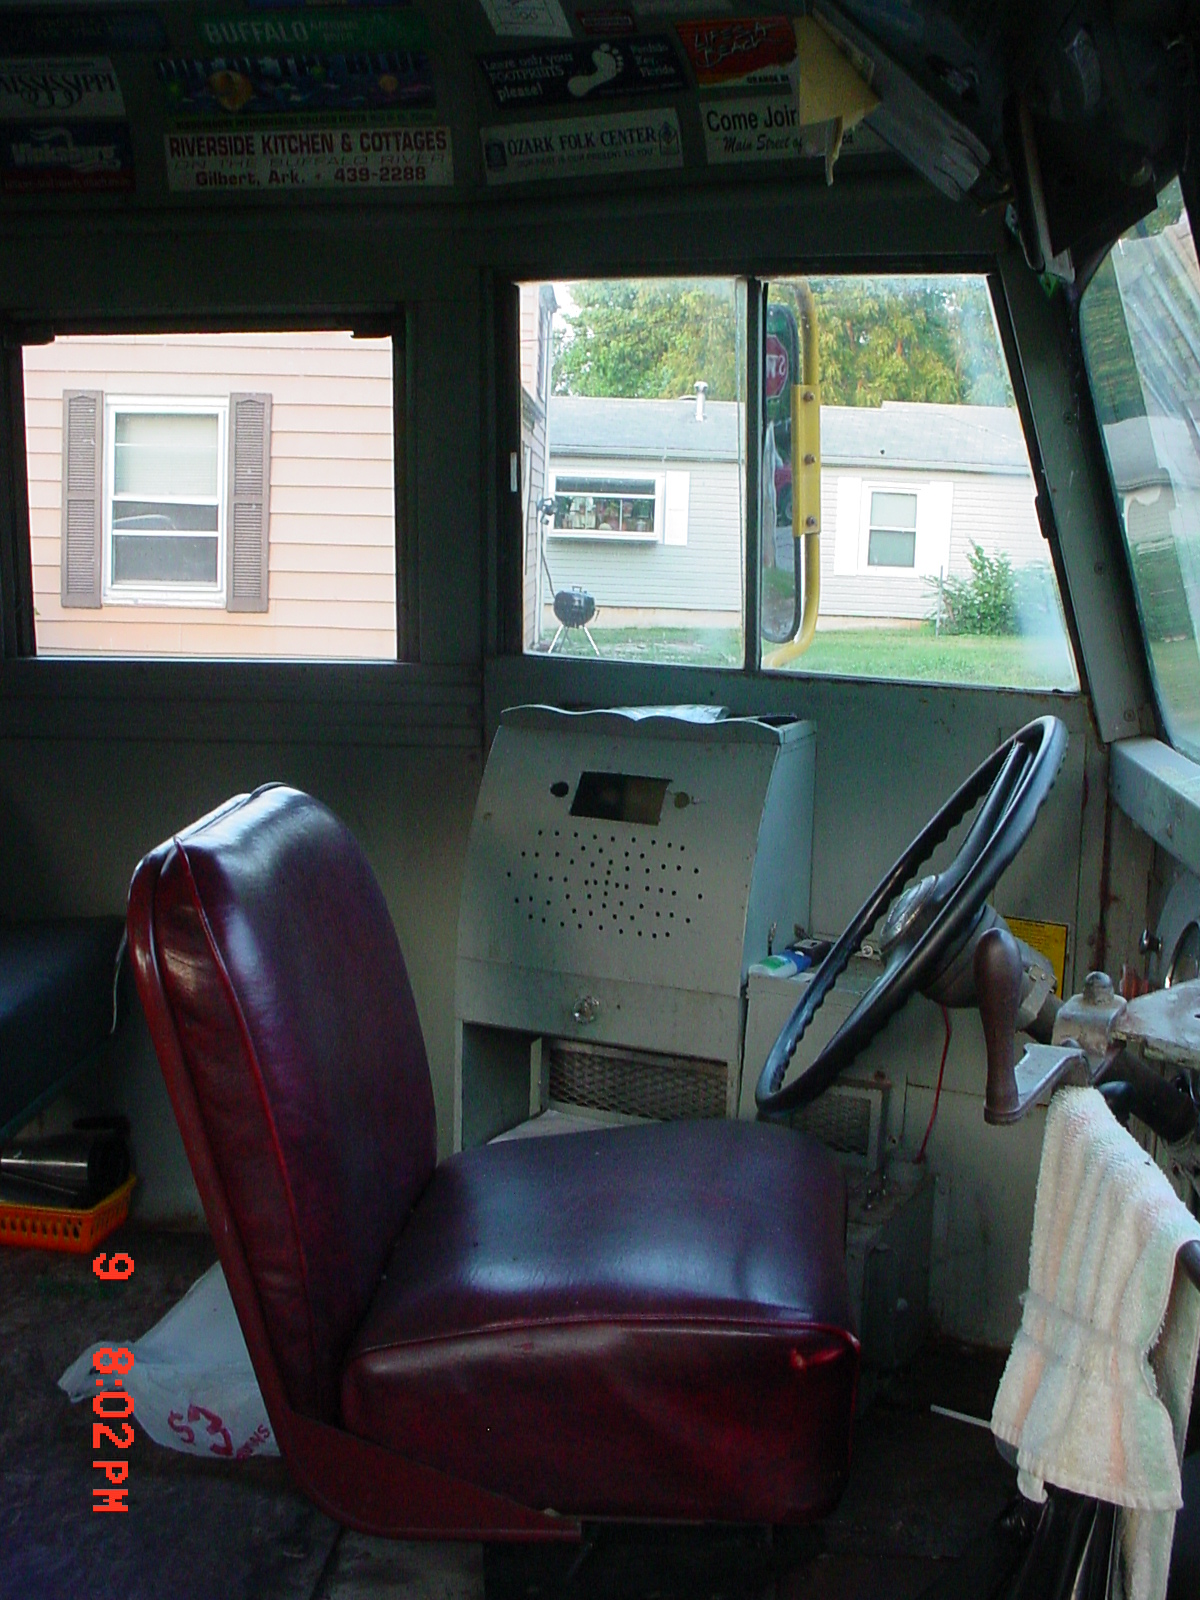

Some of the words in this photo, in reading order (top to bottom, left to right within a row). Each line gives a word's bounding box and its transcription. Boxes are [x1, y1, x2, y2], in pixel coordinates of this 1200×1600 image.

[204, 21, 309, 44] BUFFALO
[488, 64, 565, 85] FOOTPRINTS
[706, 110, 759, 132] Come
[169, 135, 256, 158] RIVERSIDE
[262, 133, 335, 155] KITCHEN
[341, 135, 353, 153] &
[360, 130, 447, 152] COTTAGES
[507, 139, 554, 156] OZARK
[559, 132, 596, 150] FOLK
[600, 126, 658, 147] CENTER
[722, 136, 753, 153] Main
[757, 133, 790, 152] Street
[270, 156, 368, 168] BUFFALO
[381, 154, 446, 165] RIVER
[195, 171, 261, 187] Gilbert,
[268, 170, 306, 184] Ark.
[334, 166, 426, 182] 439-2288
